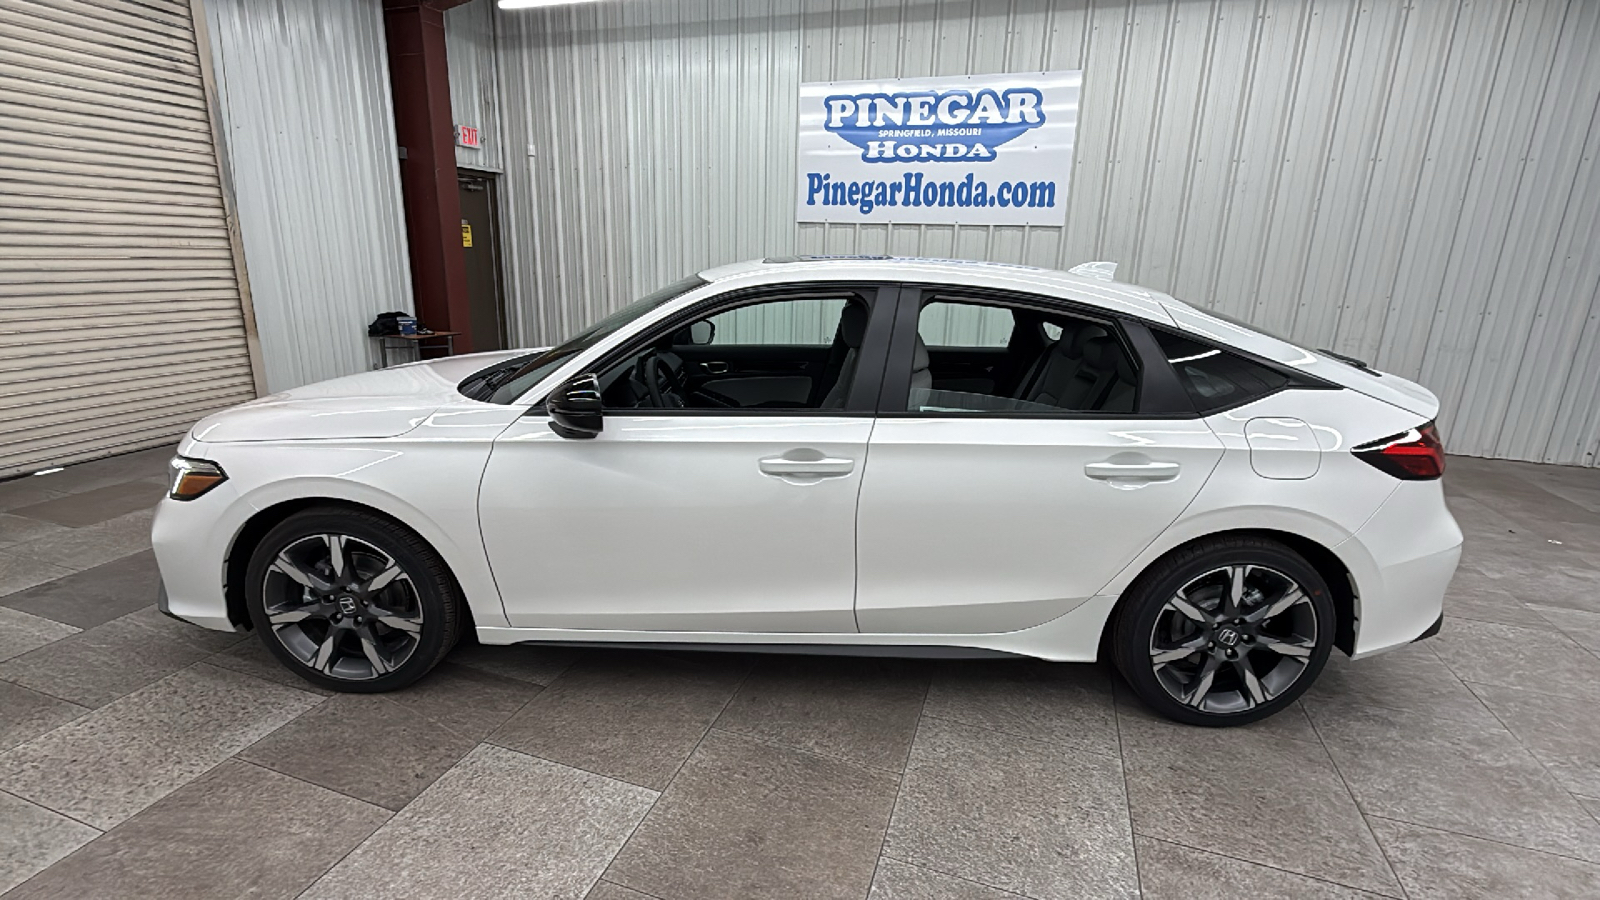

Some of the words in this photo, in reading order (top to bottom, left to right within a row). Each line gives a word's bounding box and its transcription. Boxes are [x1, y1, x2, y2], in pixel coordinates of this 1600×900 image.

[828, 92, 1041, 128] PINEGAR
[462, 126, 478, 145] EXIT
[878, 129, 935, 138] SPRINGFIELD,
[937, 128, 982, 136] MISSOURI
[806, 172, 1056, 215] PinegarHonda.com
